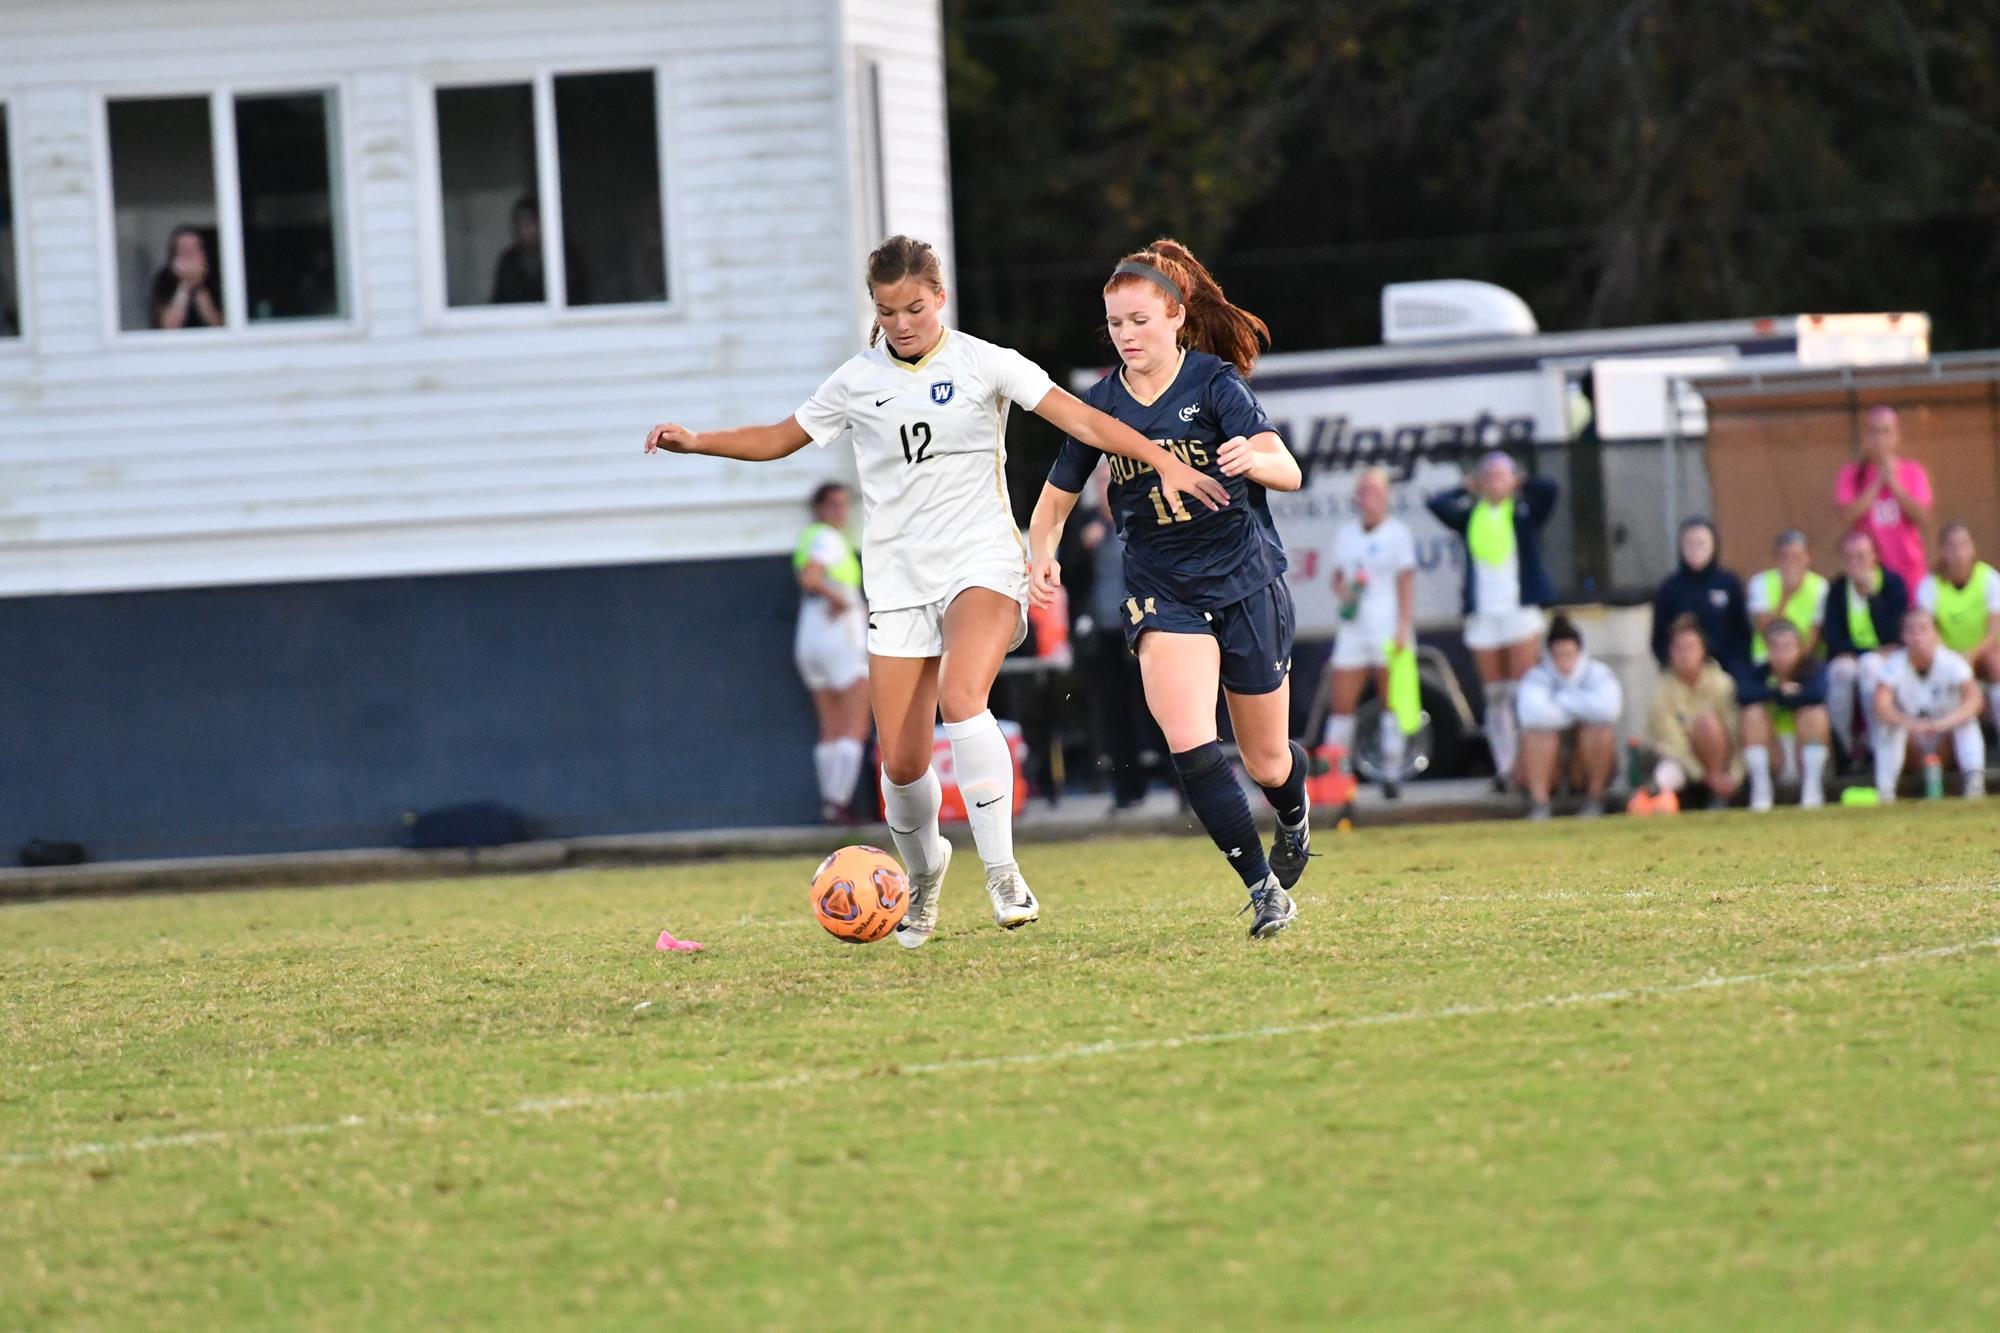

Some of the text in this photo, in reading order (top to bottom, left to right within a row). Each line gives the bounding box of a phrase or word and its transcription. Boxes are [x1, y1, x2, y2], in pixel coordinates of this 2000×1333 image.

[932, 383, 953, 402] W
[900, 421, 934, 465] 12
[1109, 438, 1210, 486] QUNS
[1148, 485, 1193, 526] 11
